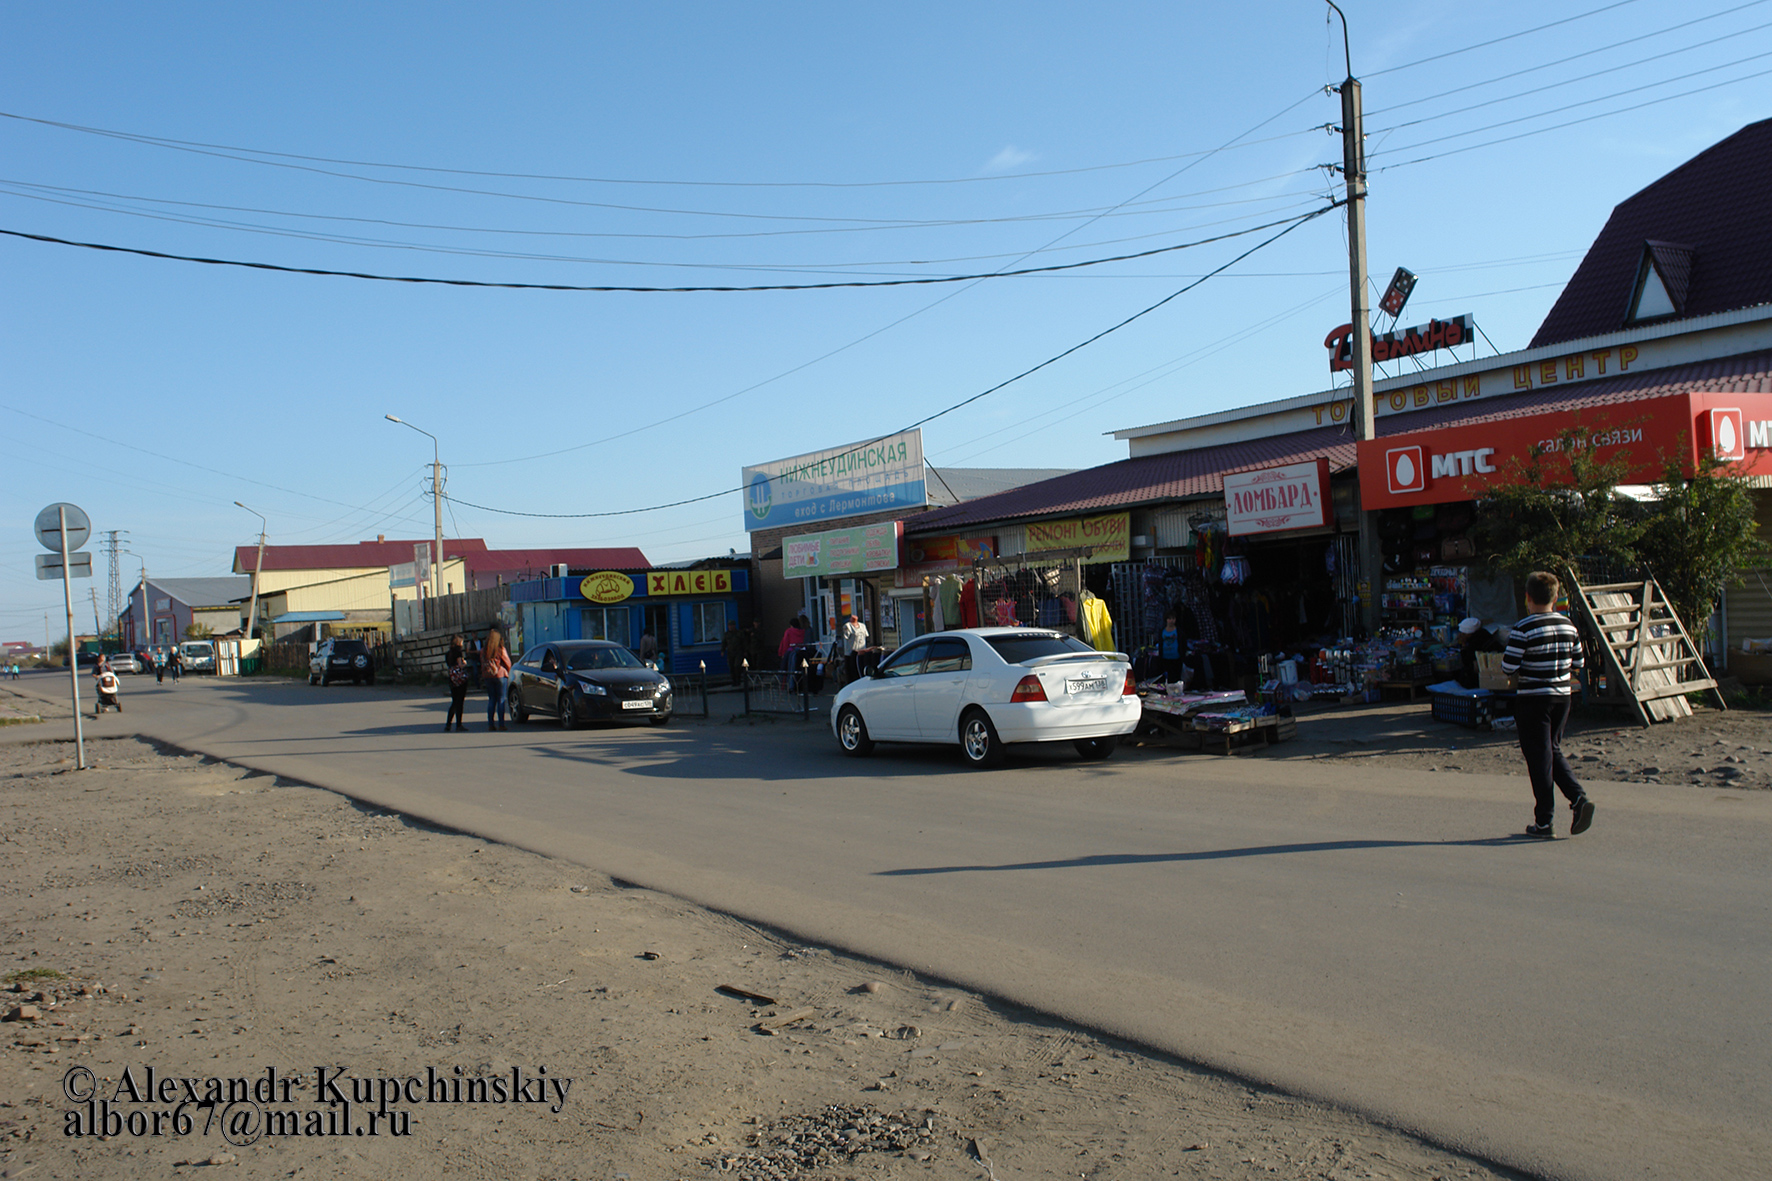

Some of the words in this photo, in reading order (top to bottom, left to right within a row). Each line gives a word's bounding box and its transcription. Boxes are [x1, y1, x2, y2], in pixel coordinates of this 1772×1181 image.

[1513, 345, 1639, 391] ЦЕНТР
[1592, 428, 1643, 447] связи
[1749, 420, 1772, 448] М
[780, 441, 908, 485] НИЖНЕУДИНСКАЯ
[1431, 447, 1497, 480] МТС
[781, 481, 839, 499] ТОРГОВАЯ
[1233, 482, 1313, 515] ЛОМБАРД
[794, 502, 818, 518] вход
[821, 503, 827, 514] с
[830, 491, 896, 513] Лермонтова
[1029, 522, 1078, 542] РЕМОНТ
[1083, 516, 1127, 538] ОБУВИ
[788, 555, 805, 567] ДЕТИ
[652, 574, 728, 592] ХЛЕБ
